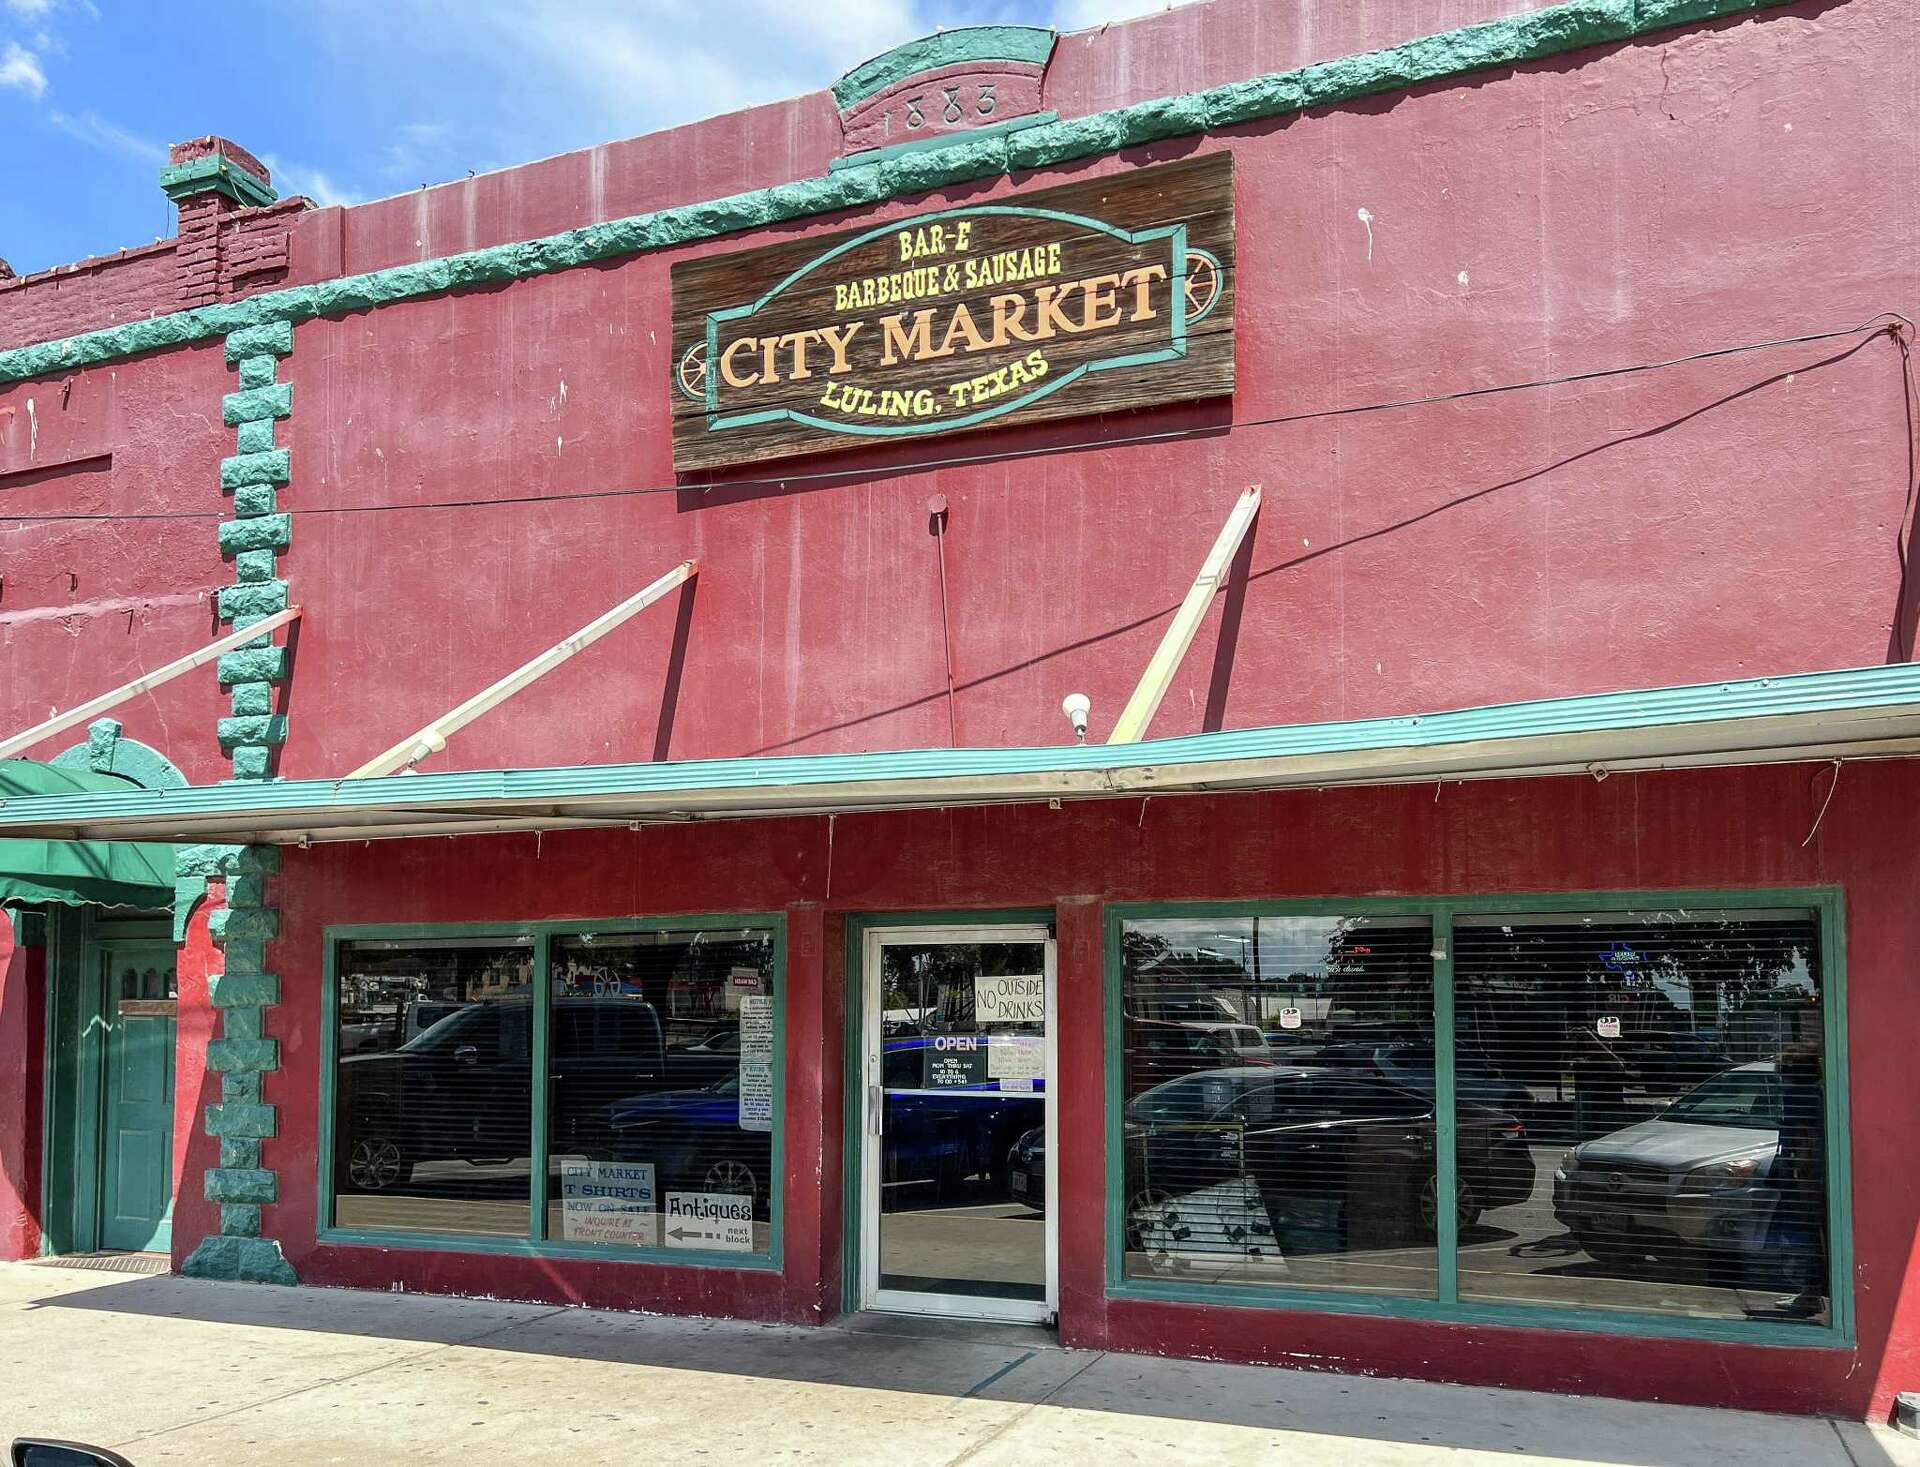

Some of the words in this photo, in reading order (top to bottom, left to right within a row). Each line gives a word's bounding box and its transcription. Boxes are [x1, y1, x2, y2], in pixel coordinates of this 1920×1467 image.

[883, 85, 997, 137] 1883
[899, 221, 972, 262] BAR-E
[835, 267, 940, 311] BARBEQUE
[944, 268, 961, 294] &
[965, 243, 1062, 287] SAUSAGE
[721, 321, 865, 387] CITY
[880, 265, 1167, 367] MARKET
[820, 381, 942, 418] LULING,
[949, 349, 1049, 409] TEXAS
[998, 979, 1044, 996] OUTSIDE
[977, 991, 997, 1009] NO
[998, 1001, 1044, 1019] DRINKS
[935, 1036, 977, 1051] OPEN
[567, 1166, 593, 1178] CITY
[598, 1167, 648, 1181] MARKET
[564, 1184, 576, 1195] T
[582, 1184, 651, 1200] SHIRTS
[567, 1201, 593, 1212] NOW
[599, 1202, 615, 1213] ON
[669, 1197, 752, 1225] Antiques
[584, 1215, 622, 1227] INQUIRE
[622, 1218, 635, 1228] AT
[575, 1227, 602, 1238] FRONT
[725, 1233, 751, 1244] block
[727, 1226, 748, 1237] next
